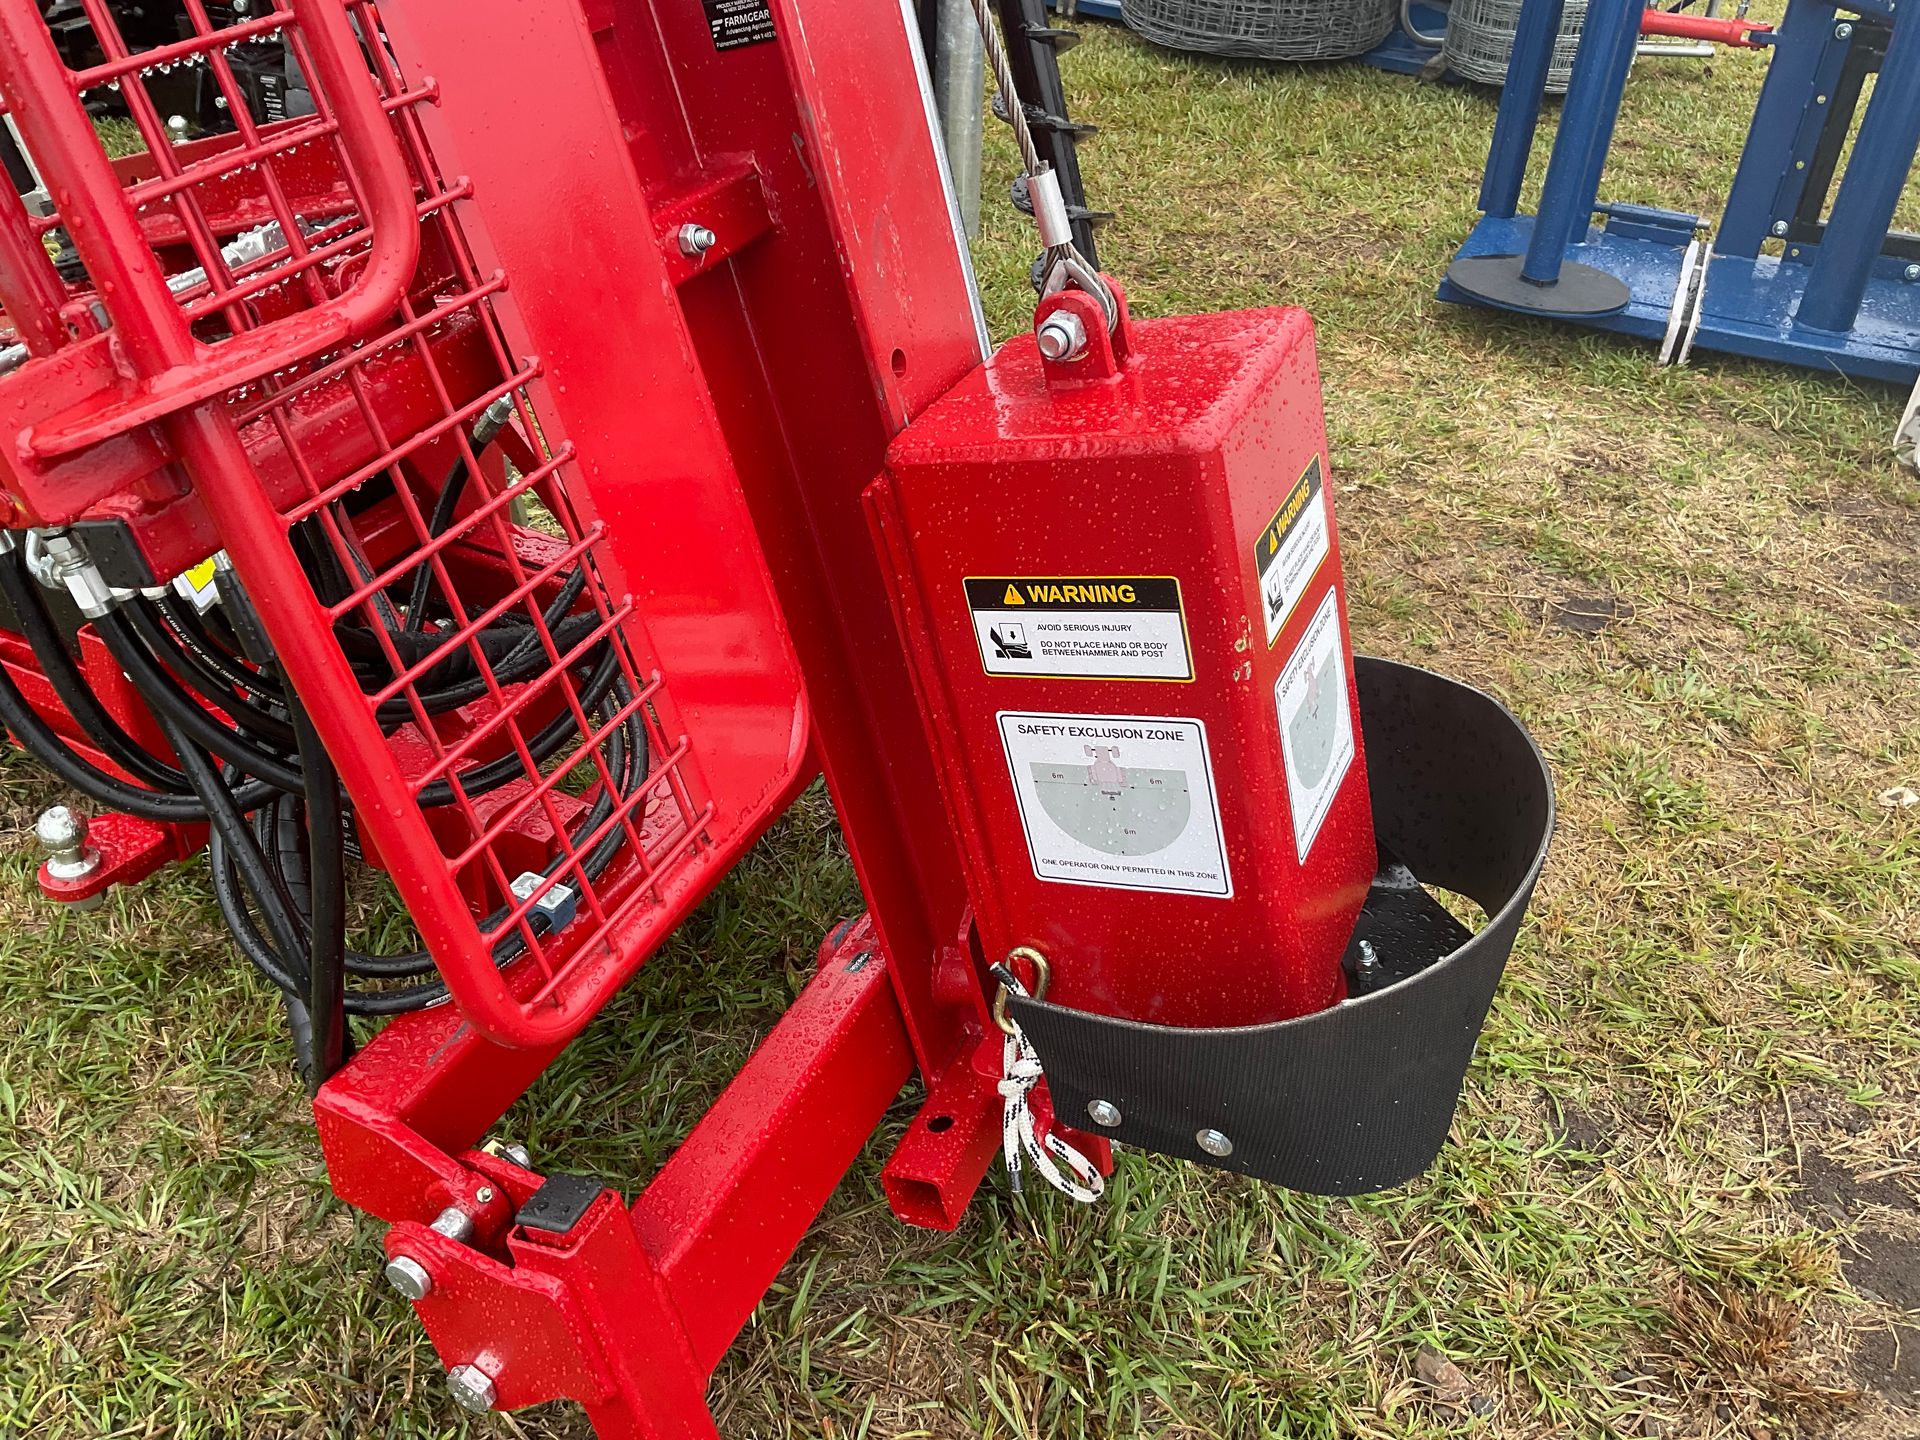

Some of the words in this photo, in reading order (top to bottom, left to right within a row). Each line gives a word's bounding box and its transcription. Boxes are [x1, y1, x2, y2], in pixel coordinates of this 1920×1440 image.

[724, 9, 770, 27] FARMGEAR
[726, 25, 751, 35] Advancing
[1276, 478, 1310, 539] WARNING
[1026, 584, 1136, 603] WARNING
[1063, 624, 1100, 632] SERIOUS
[1102, 624, 1132, 632] INJURY
[1073, 641, 1101, 649] PLACE
[1102, 641, 1127, 649] HAND
[1144, 642, 1168, 650] BODY
[1141, 650, 1164, 658] POST
[1017, 724, 1065, 736] SAFETY
[1069, 726, 1143, 739] EXCLUSION
[1146, 730, 1185, 741] ZONE
[1042, 858, 1058, 866] ONE
[1059, 860, 1099, 869] OPERATOR
[1101, 863, 1120, 871] ONLY
[1122, 866, 1166, 875] PERMITTED
[1177, 870, 1195, 878] THIS
[1196, 871, 1218, 880] ZONE
